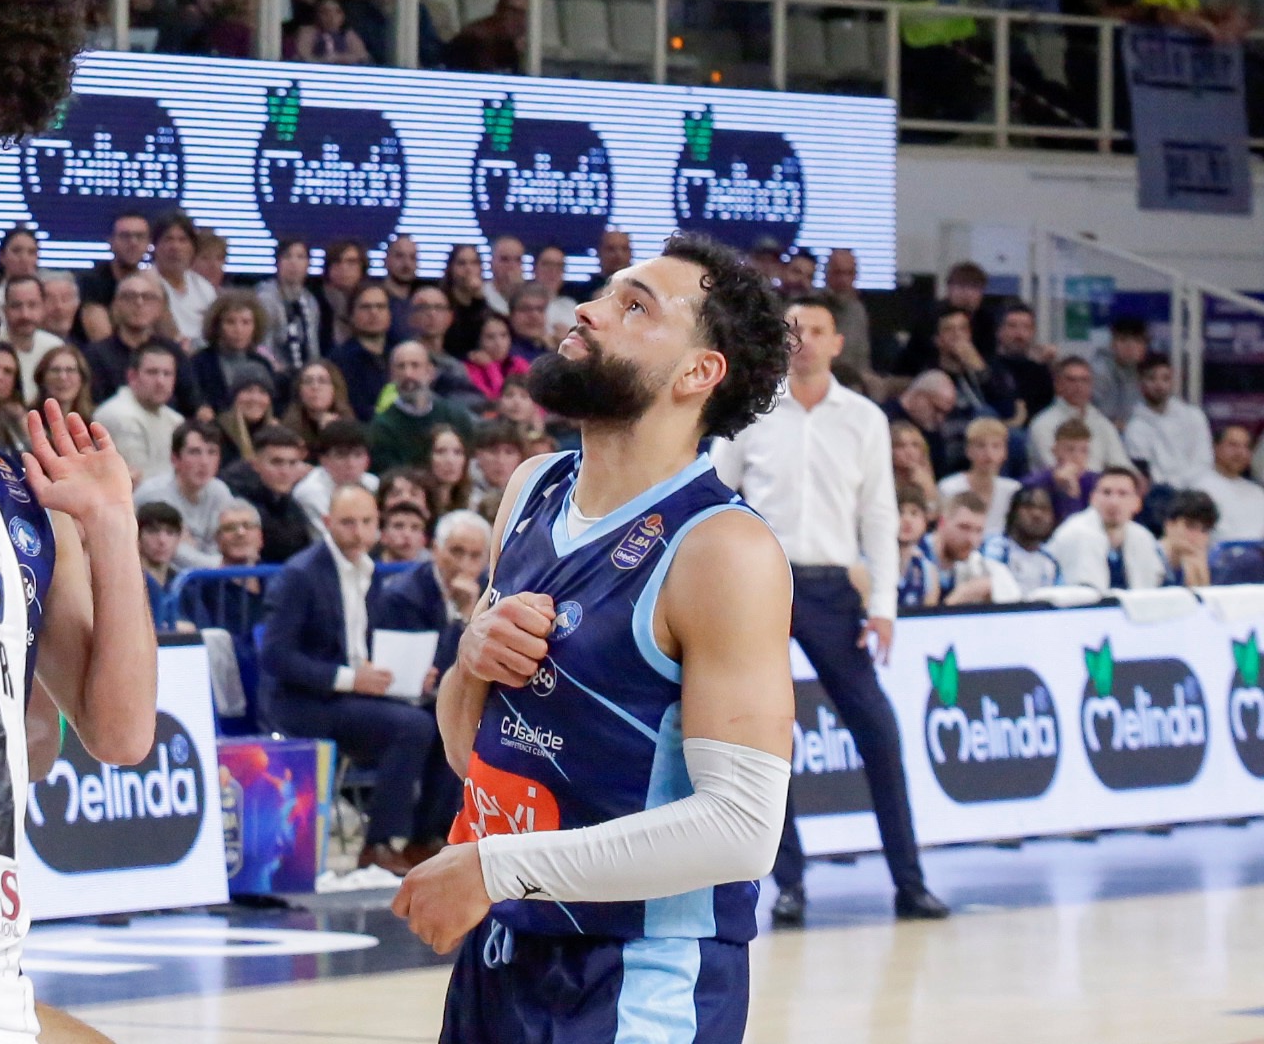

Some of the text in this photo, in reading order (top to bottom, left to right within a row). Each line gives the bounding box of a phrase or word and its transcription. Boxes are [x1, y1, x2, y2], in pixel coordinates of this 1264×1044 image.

[628, 533, 651, 549] LBA
[928, 692, 1057, 764] Melinda
[1084, 683, 1206, 752] Melinda
[28, 743, 198, 827] Melinda
